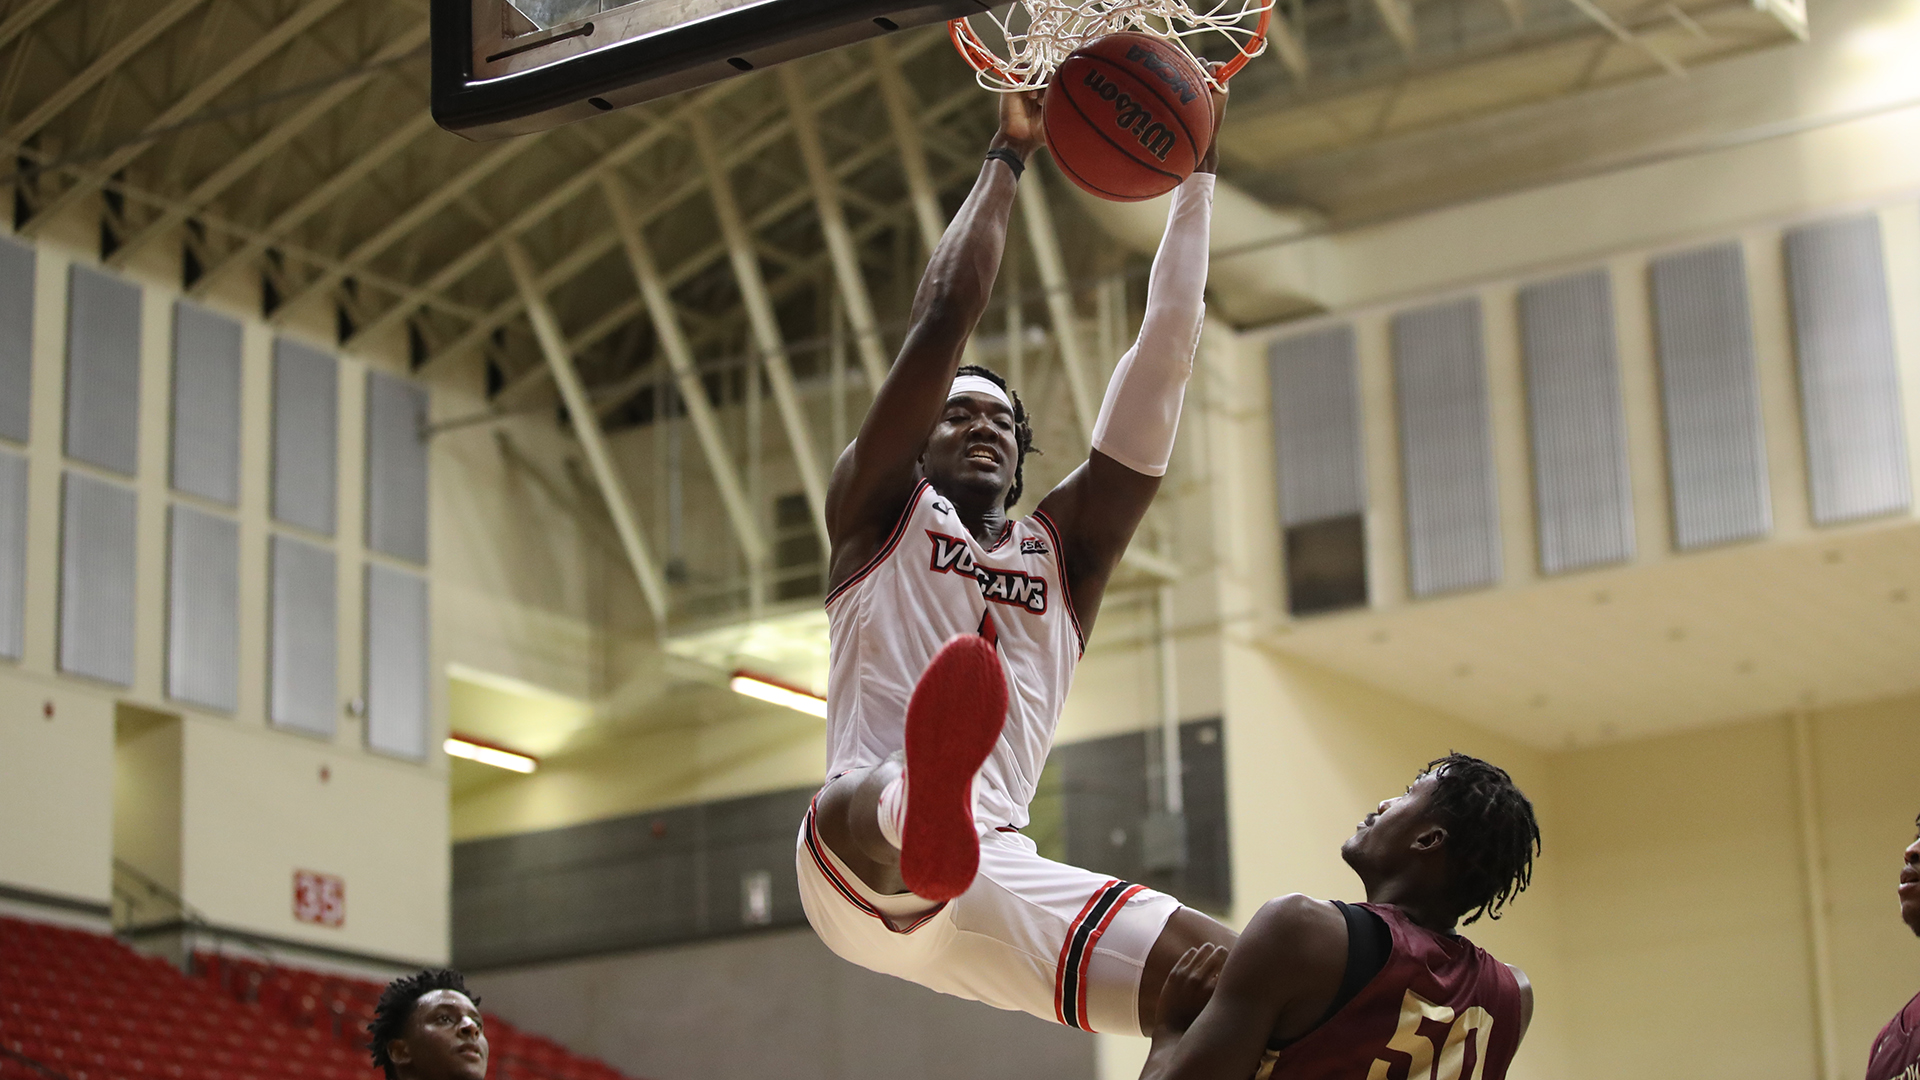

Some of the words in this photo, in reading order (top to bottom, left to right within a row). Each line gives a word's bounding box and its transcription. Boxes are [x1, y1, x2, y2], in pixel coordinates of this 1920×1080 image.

[1083, 68, 1177, 163] Wilson
[1125, 44, 1198, 106] NCAA
[930, 532, 1047, 613] VUCANS
[1020, 540, 1046, 551] PSA
[1365, 987, 1495, 1080] 50
